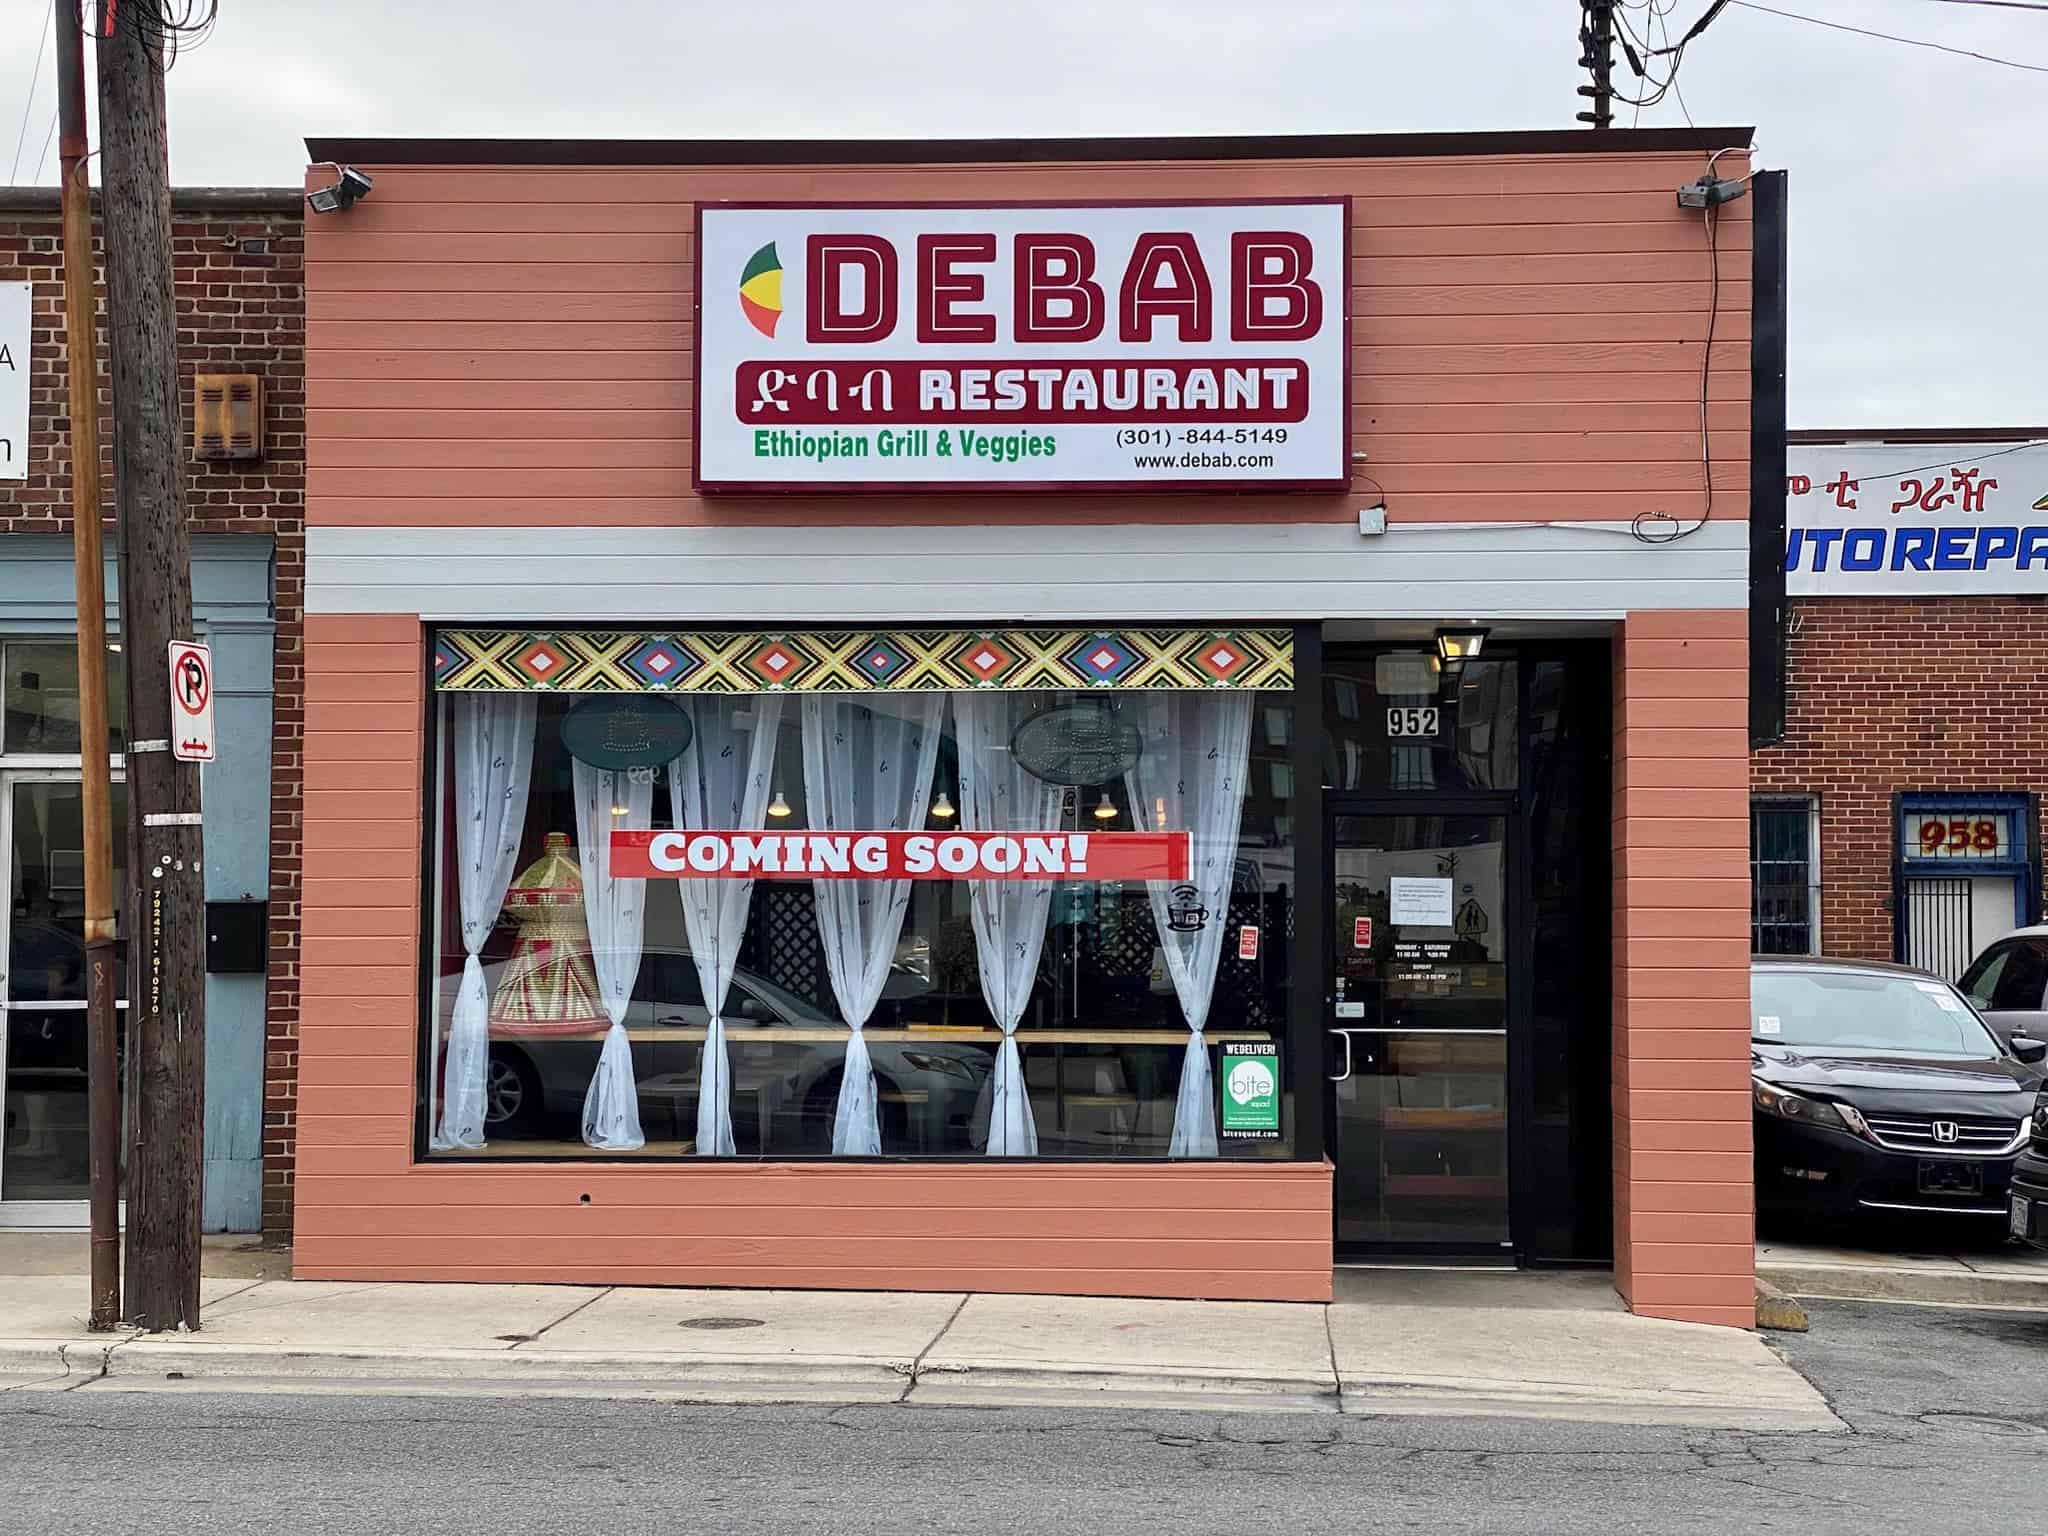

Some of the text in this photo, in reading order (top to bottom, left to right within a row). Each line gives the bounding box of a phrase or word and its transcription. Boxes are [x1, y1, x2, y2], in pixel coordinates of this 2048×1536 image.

[806, 231, 1323, 343] DEBAB
[751, 369, 893, 412] ድባብ
[919, 367, 1298, 411] RESTAURANT
[754, 429, 1056, 462] Ethiopian Grill & Veggies
[1116, 428, 1172, 448] (301)
[1134, 452, 1274, 468] www.debab.com
[1390, 709, 1437, 735] 952
[648, 834, 1089, 873] COMING SOON!
[1919, 820, 1998, 854] 958
[1232, 1071, 1271, 1095] bite
